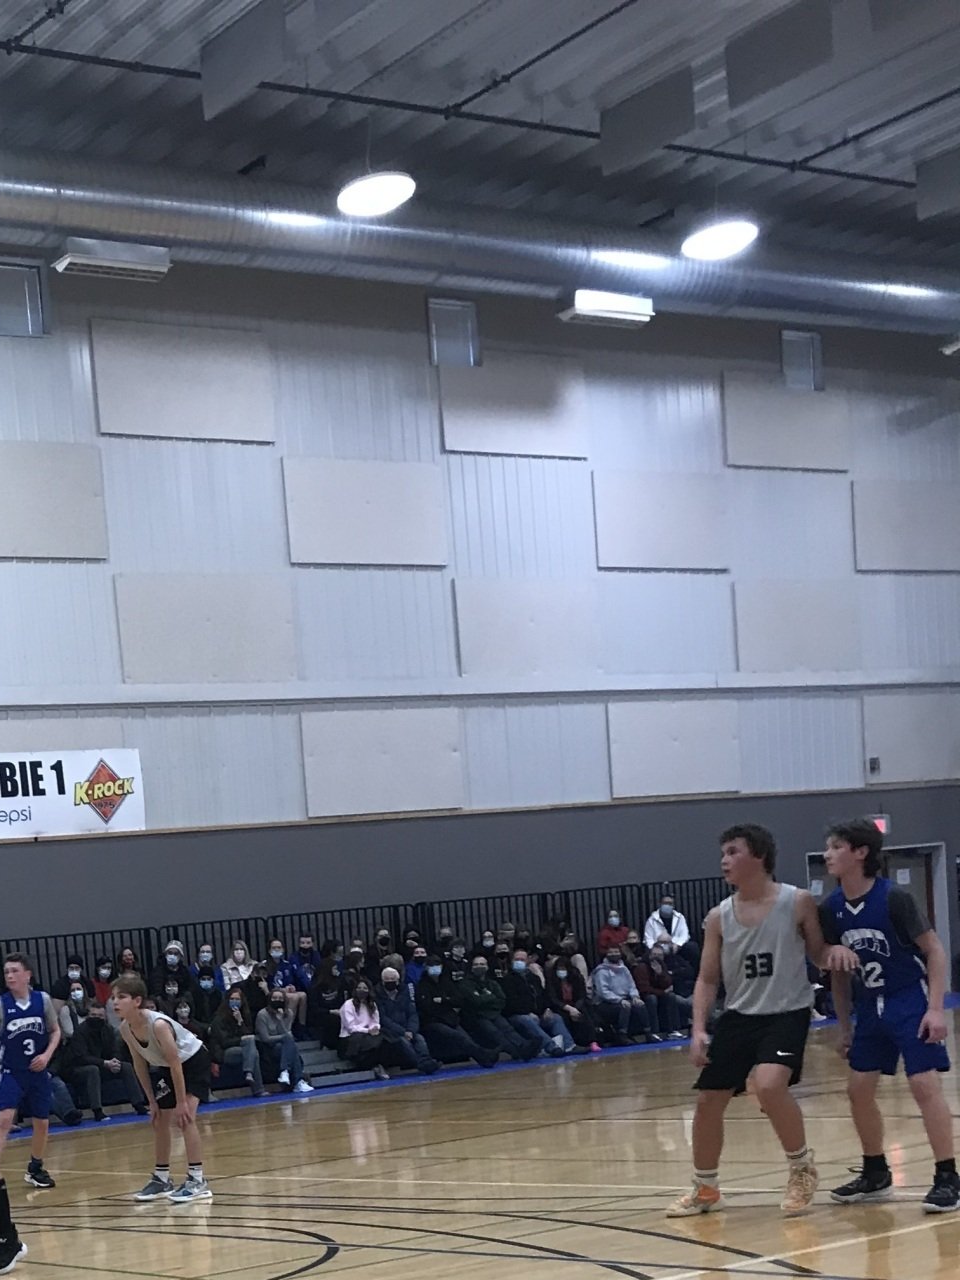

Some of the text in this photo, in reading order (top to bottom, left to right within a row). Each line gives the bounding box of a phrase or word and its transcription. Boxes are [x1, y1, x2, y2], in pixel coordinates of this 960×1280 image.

[50, 759, 66, 795] 1
[74, 777, 134, 806] K-ROCK
[745, 952, 773, 979] 33
[23, 1038, 36, 1056] 3
